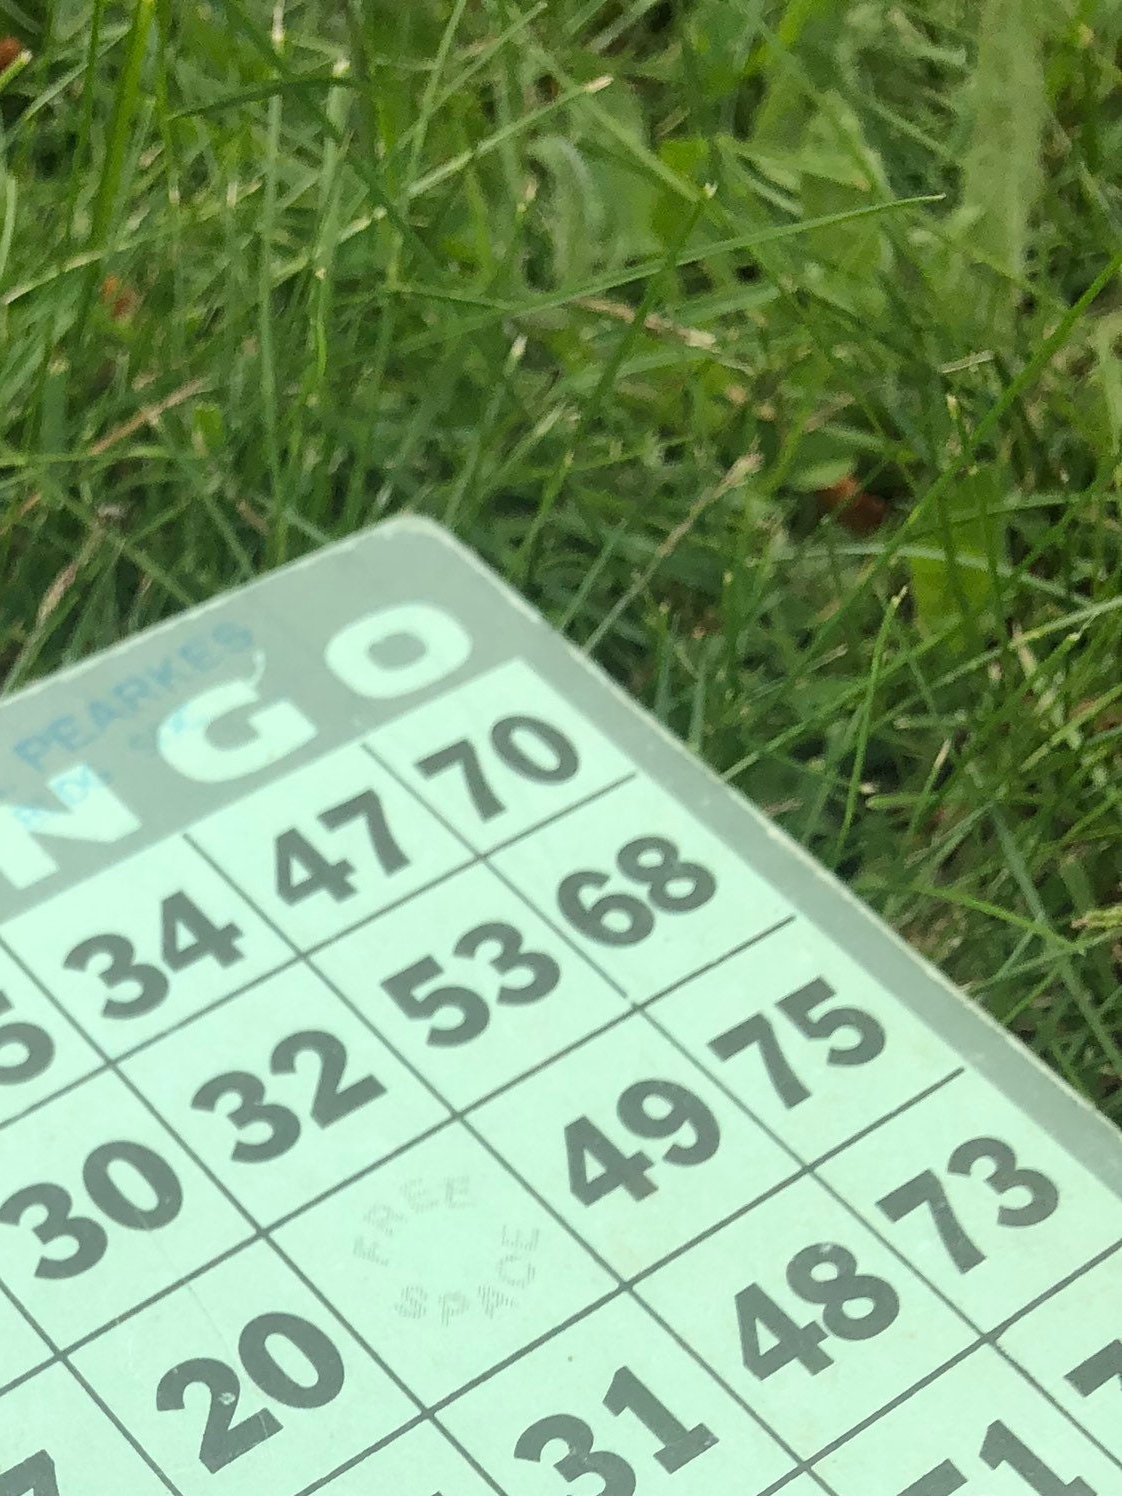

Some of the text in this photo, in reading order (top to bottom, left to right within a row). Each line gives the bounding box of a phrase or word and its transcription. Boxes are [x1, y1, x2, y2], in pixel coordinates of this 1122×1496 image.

[14, 621, 254, 771] PEARKES
[64, 891, 244, 1019] 34
[275, 789, 410, 905] 47
[415, 715, 579, 822] 70
[191, 1030, 387, 1163] 32
[381, 922, 560, 1047] 53
[557, 836, 716, 947] 68
[564, 977, 886, 1206] 49 75
[353, 1176, 475, 1266] FREE
[395, 1225, 539, 1326] SPACE
[735, 1243, 900, 1381] 48
[875, 1137, 1059, 1274] 73
[156, 1312, 344, 1474] 20
